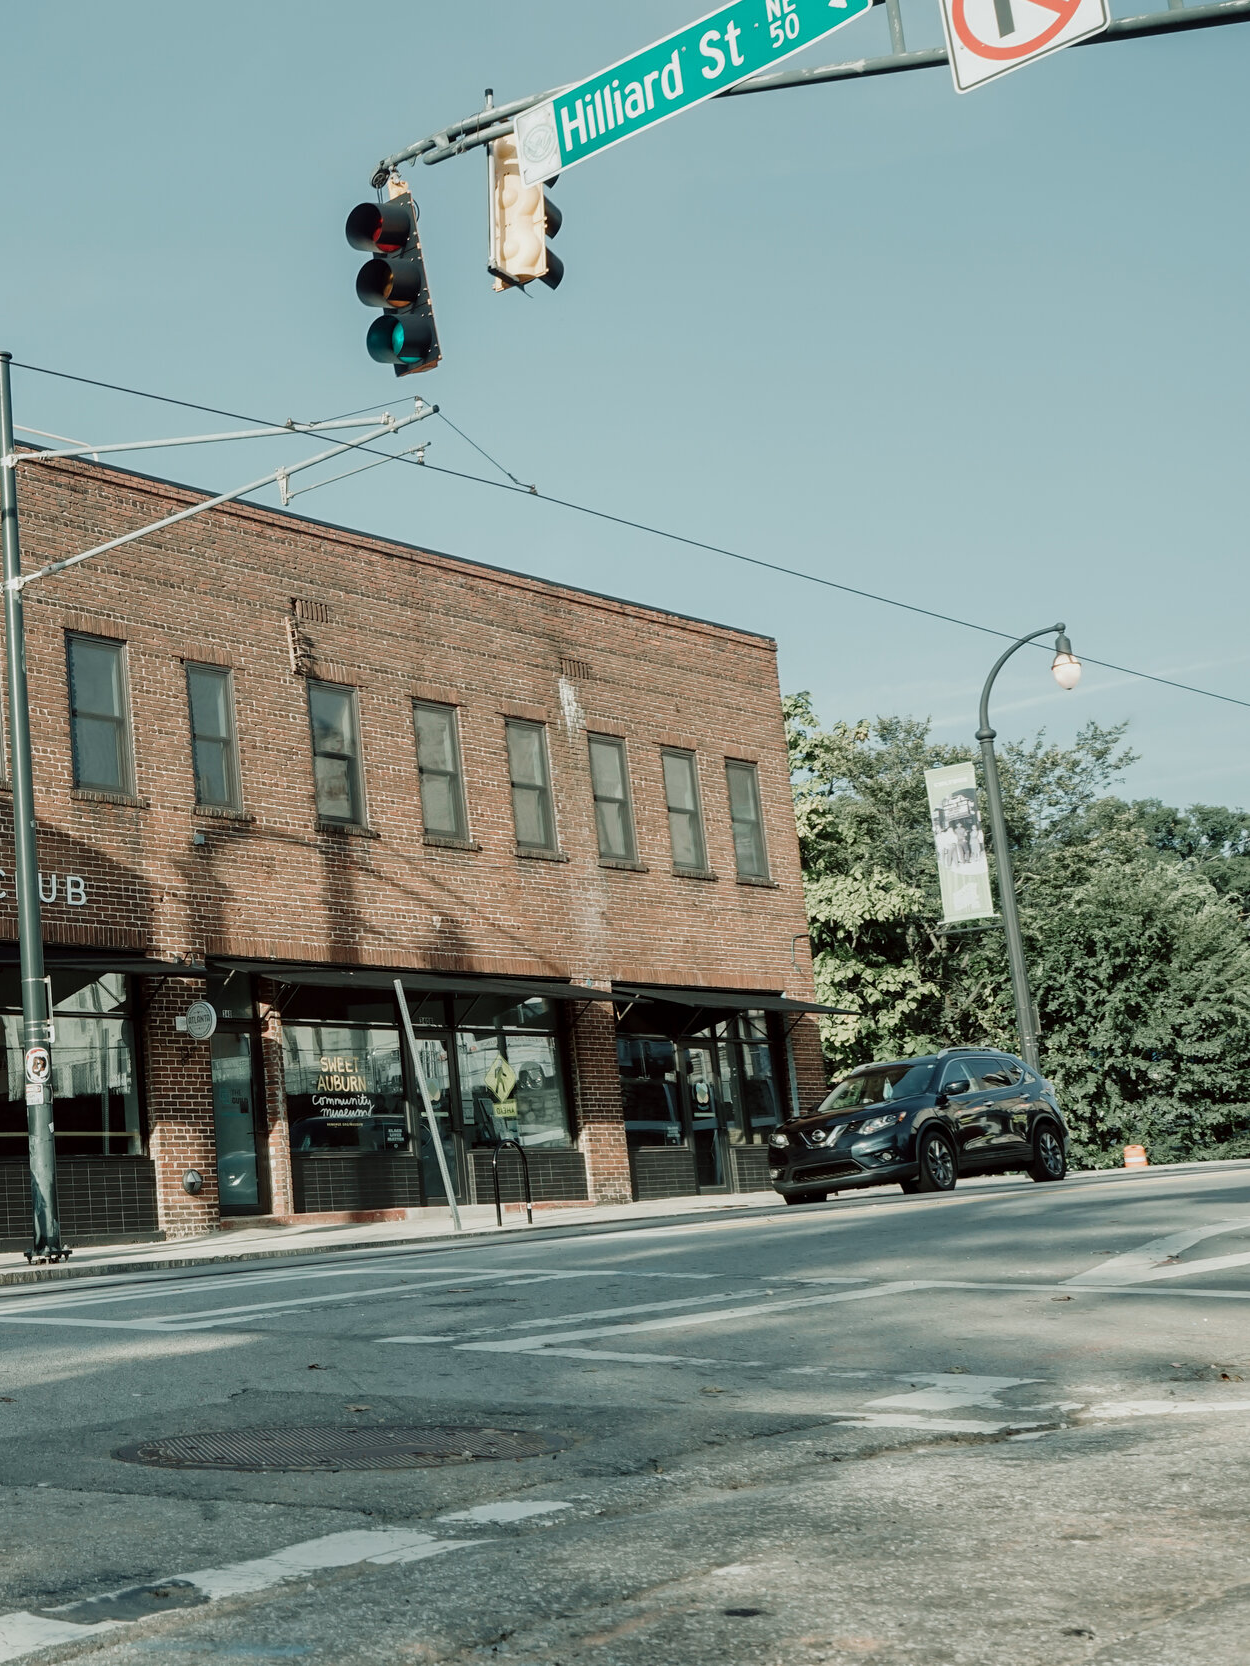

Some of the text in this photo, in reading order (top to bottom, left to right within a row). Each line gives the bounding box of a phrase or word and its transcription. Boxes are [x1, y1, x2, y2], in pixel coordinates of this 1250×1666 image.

[769, 13, 799, 48] 50
[560, 19, 744, 152] Hilliard St
[189, 1014, 210, 1024] ATLANTA
[320, 1056, 359, 1073] SWEET
[317, 1074, 367, 1092] AUBURN
[312, 1093, 375, 1117] Community
